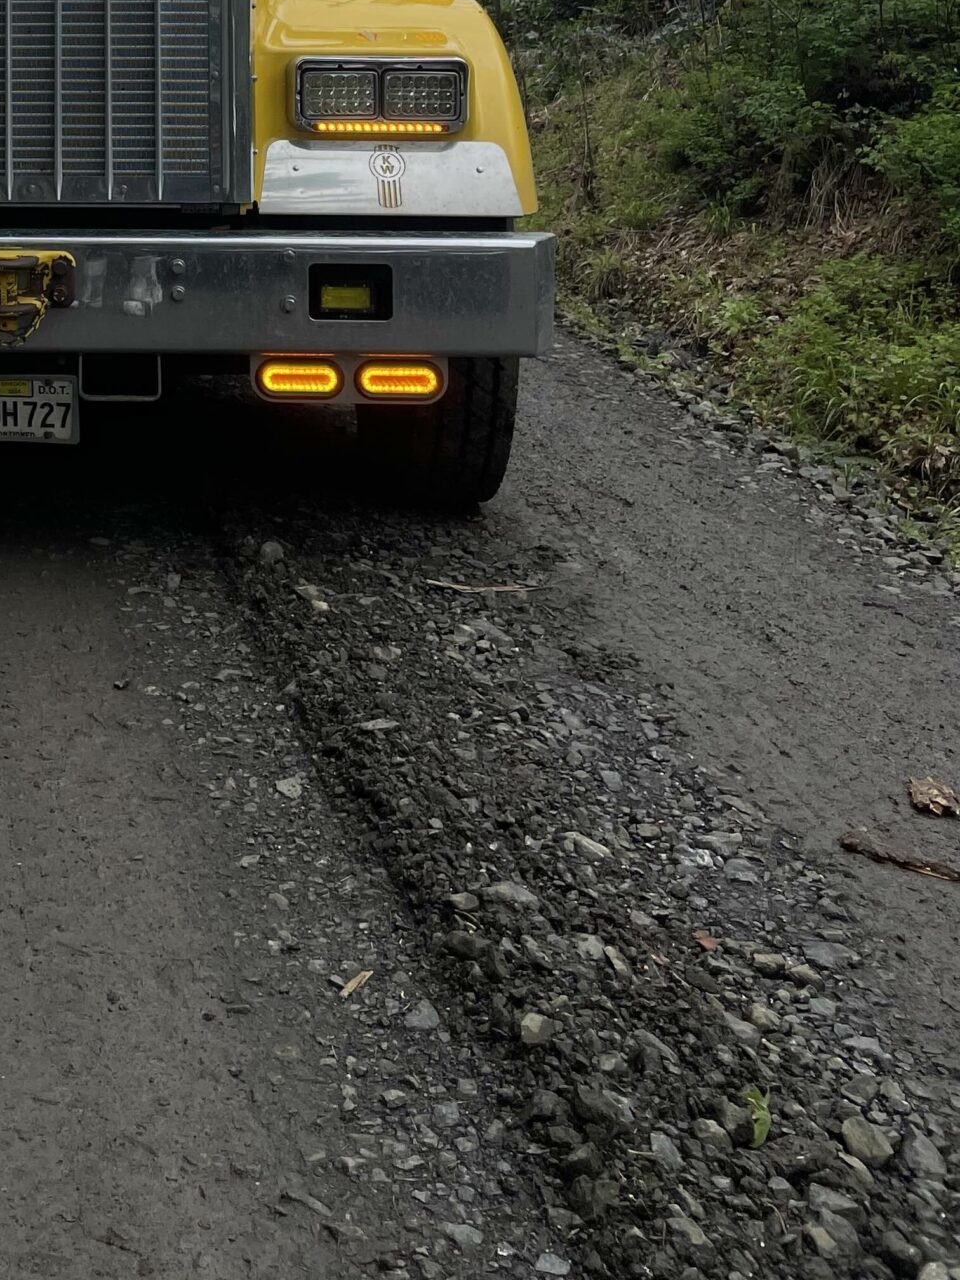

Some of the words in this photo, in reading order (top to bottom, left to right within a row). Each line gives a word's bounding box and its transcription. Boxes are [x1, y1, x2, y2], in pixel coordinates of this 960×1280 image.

[381, 155, 392, 166] K
[380, 165, 395, 175] W
[38, 385, 70, 395] D.O.T.
